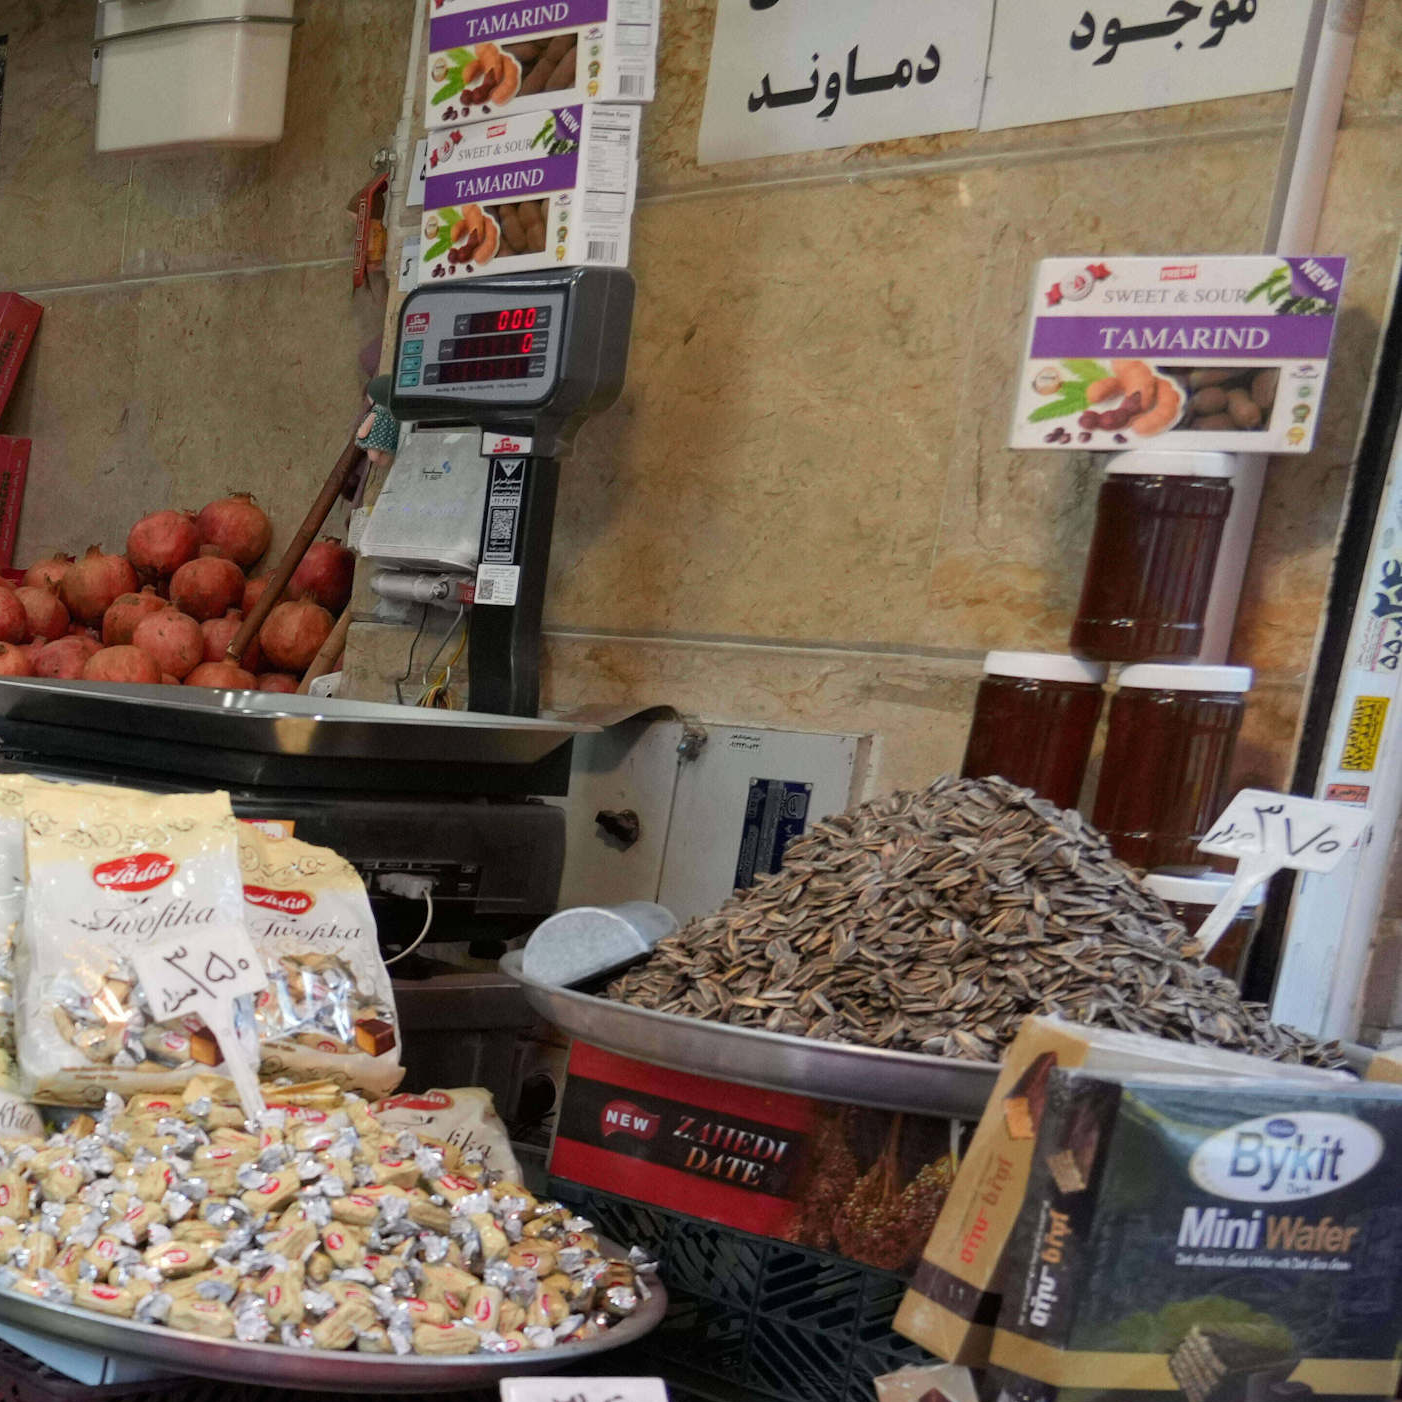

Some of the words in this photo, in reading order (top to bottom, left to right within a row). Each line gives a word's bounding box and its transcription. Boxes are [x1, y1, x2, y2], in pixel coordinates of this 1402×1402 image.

[466, 2, 570, 38] TAMARIND
[747, 43, 942, 122] دماوند
[558, 108, 581, 134] NEW
[455, 167, 544, 198] TAMARIND
[1298, 258, 1339, 292] NEW
[1103, 289, 1170, 304] SWEET
[1173, 289, 1189, 304] &
[1193, 288, 1248, 304] SOUR
[1099, 327, 1271, 350] TAMARIND
[605, 1108, 649, 1132] NEW
[672, 1114, 790, 1164] ZAHEDI
[684, 1146, 765, 1187] DATE
[1229, 1131, 1345, 1192] Bykit
[1177, 1205, 1264, 1250] Mini
[1265, 1213, 1360, 1254] Wafer
